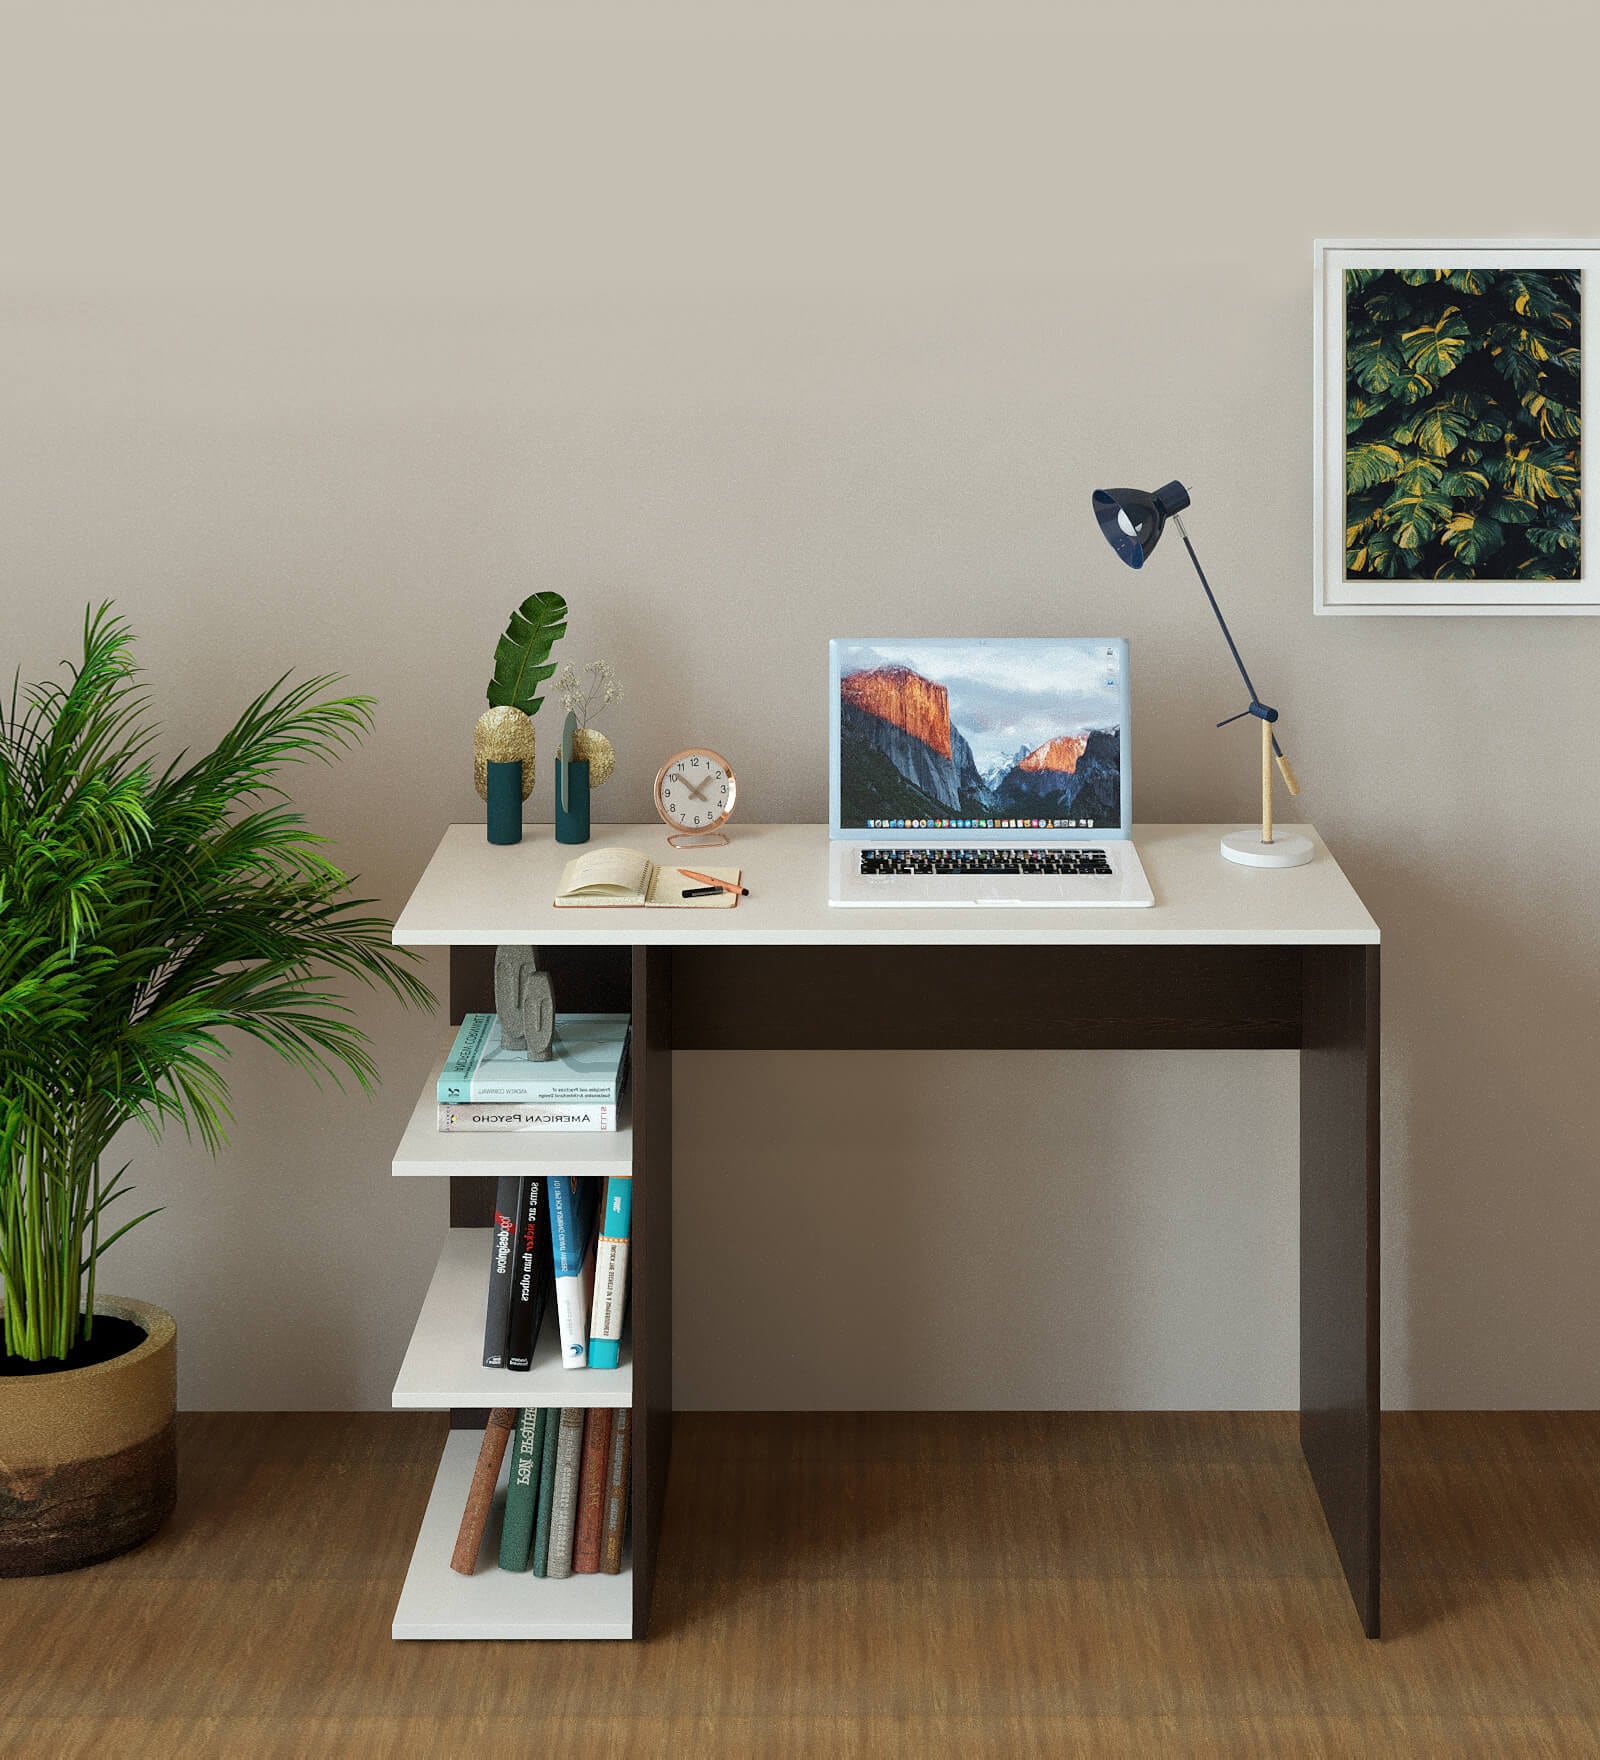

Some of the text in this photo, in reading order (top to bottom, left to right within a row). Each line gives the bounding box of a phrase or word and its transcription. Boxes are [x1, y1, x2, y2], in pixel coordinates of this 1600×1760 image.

[690, 757, 699, 767] 12
[677, 763, 685, 771] 11
[669, 773, 678, 782] 10
[716, 771, 721, 779] 2
[664, 789, 670, 797] 9
[720, 785, 726, 793] 3
[670, 803, 675, 812] 8
[680, 813, 685, 821] 7
[707, 811, 713, 819] 5
[694, 816, 700, 824] 6
